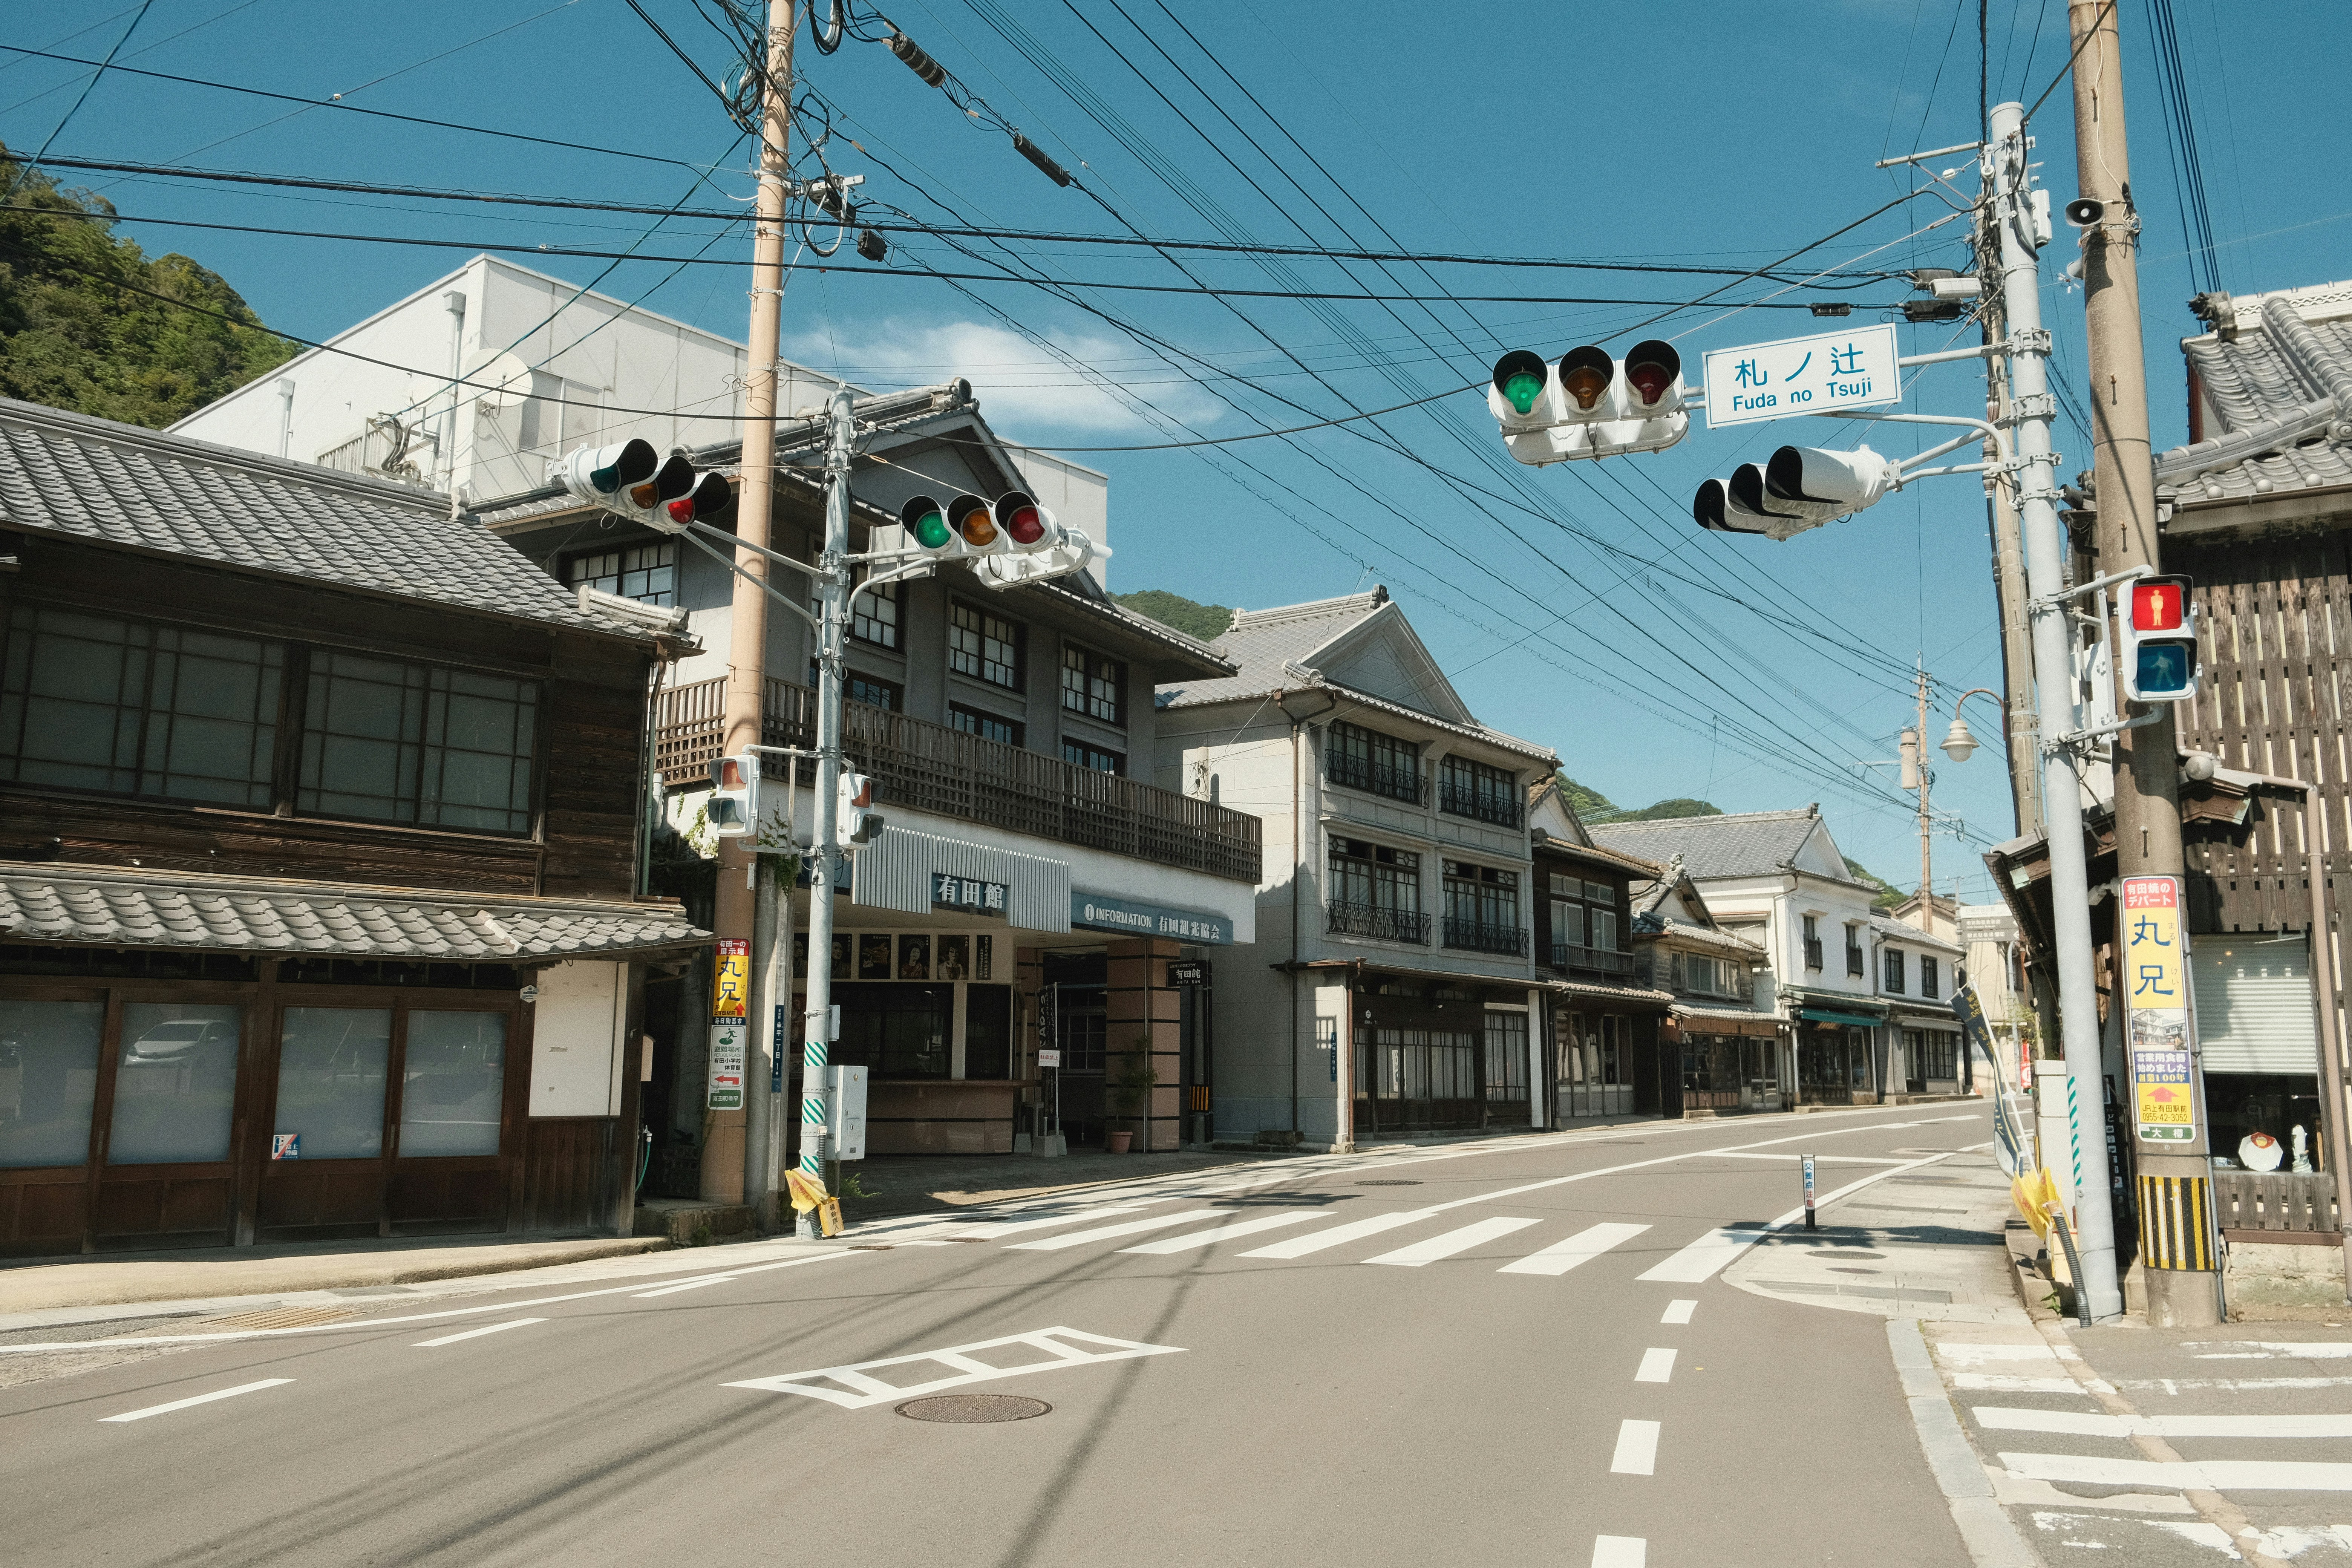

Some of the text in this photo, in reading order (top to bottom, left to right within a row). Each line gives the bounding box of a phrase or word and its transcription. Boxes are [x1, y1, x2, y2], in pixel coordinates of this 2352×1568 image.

[1735, 343, 1865, 389] 札ノ辻
[1733, 377, 1872, 411] Fuda no Tsuji
[937, 876, 1004, 909] 有田館
[2127, 882, 2170, 895] 有田焼の
[2128, 895, 2171, 906] デパート
[1095, 907, 1219, 940] INFORMATION 有田観光協会
[2131, 914, 2174, 995] 丸兄
[717, 956, 742, 1001] 丸兄
[1176, 968, 1201, 980] 有田館
[2137, 1053, 2186, 1062] 営業用食器
[2138, 1064, 2187, 1073] 始めました
[2139, 1073, 2185, 1083] 創業100年
[2142, 1105, 2187, 1113] JR上有田駅前
[2143, 1113, 2188, 1122] 0955-42-3052
[2152, 1128, 2184, 1138] 大樽
[1804, 1163, 1814, 1207] 交差点注意
